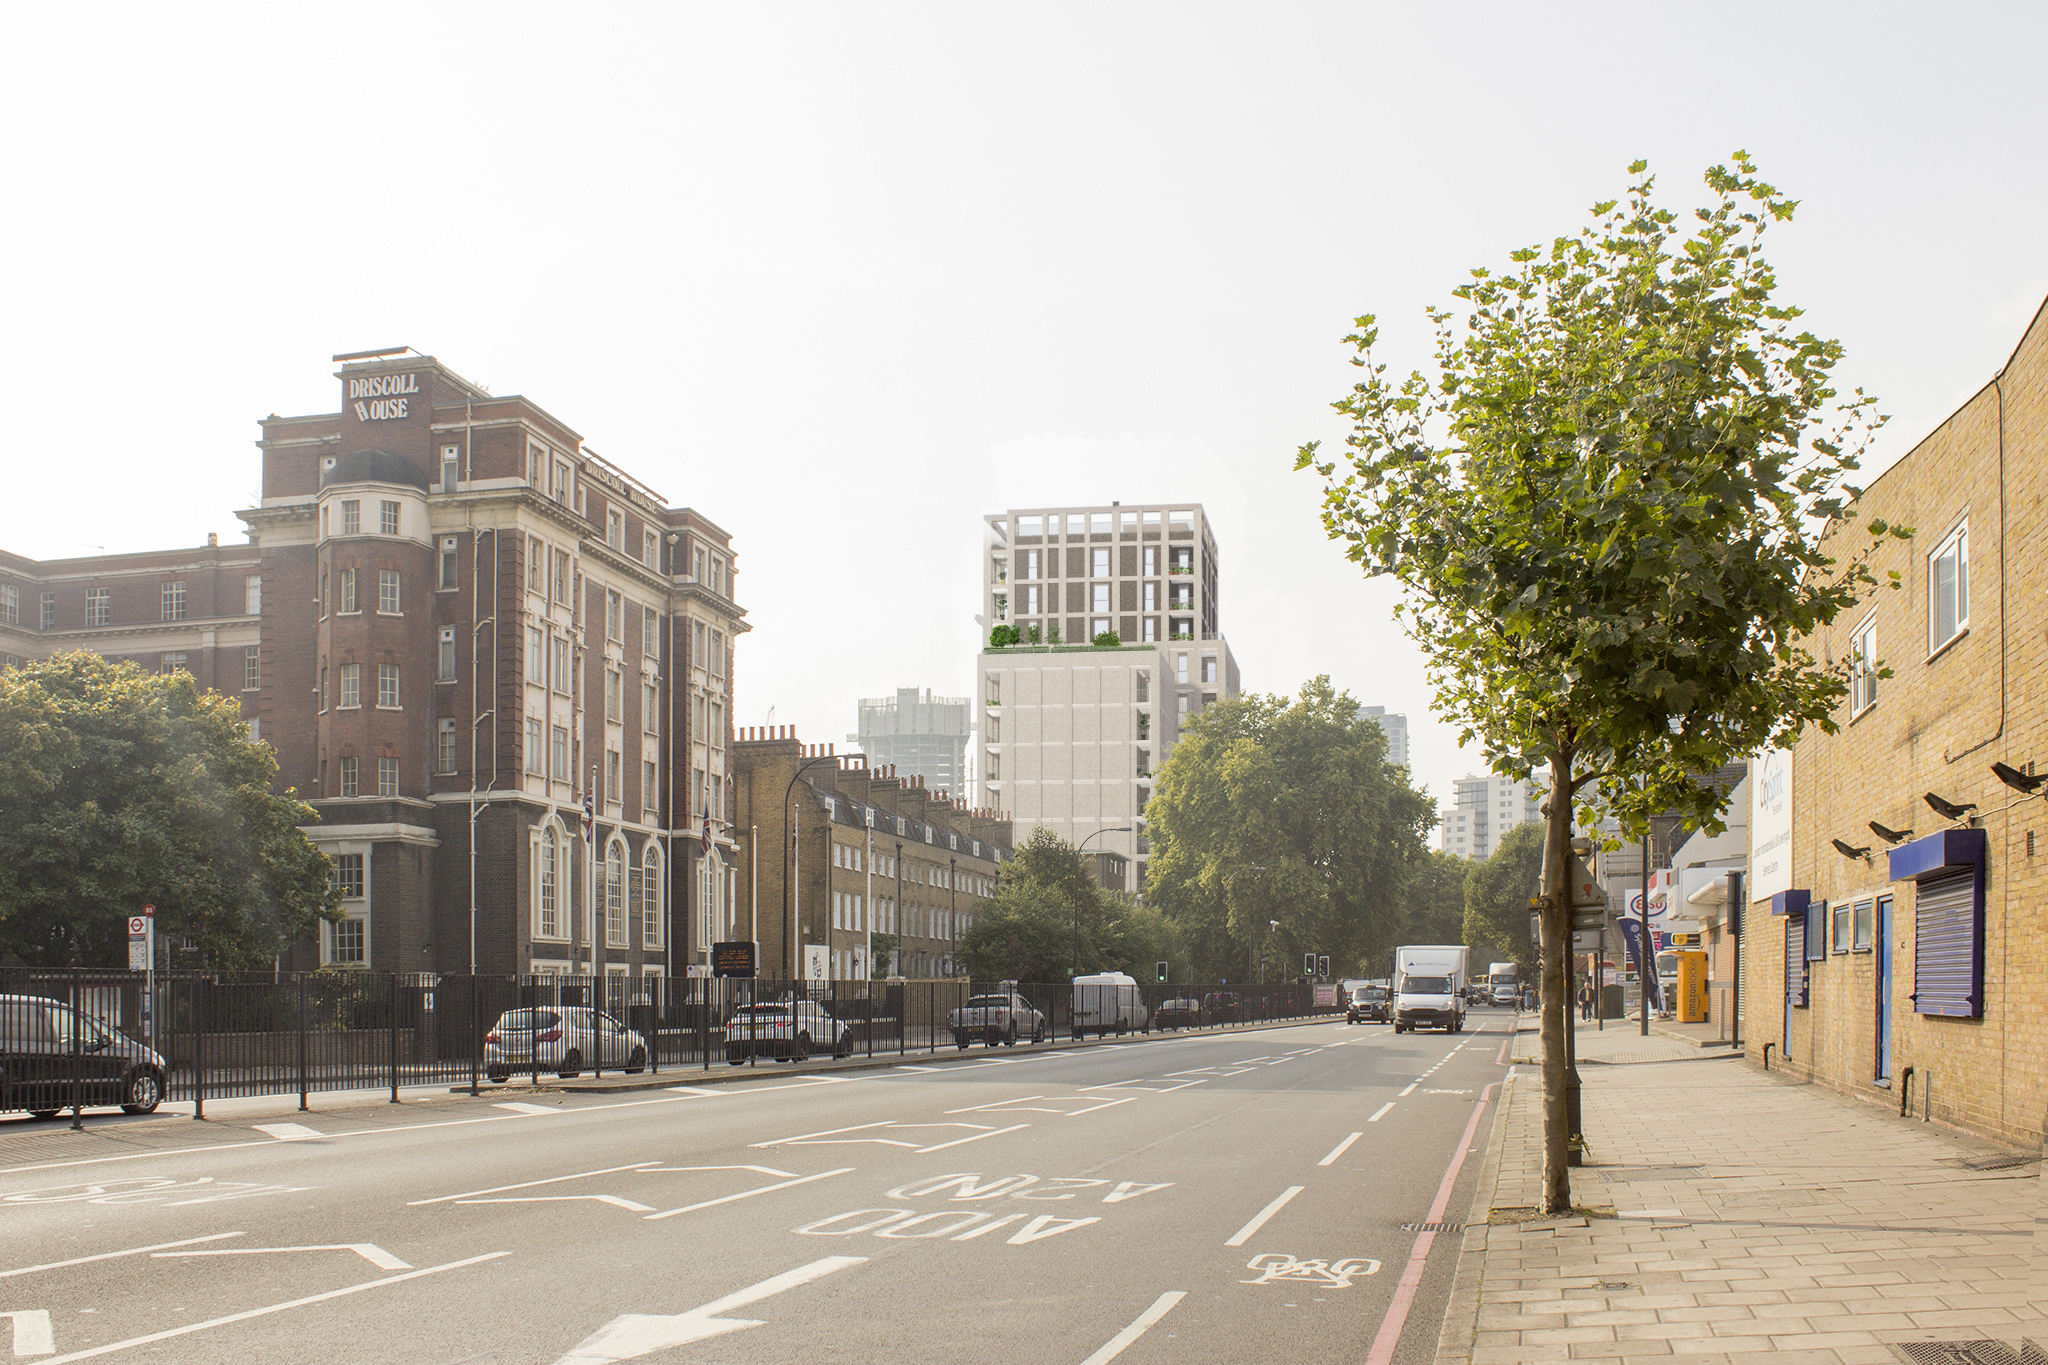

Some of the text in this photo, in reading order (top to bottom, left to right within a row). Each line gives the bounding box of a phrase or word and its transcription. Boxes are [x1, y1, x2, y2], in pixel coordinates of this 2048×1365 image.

[349, 373, 419, 399] DRISCOLL
[353, 398, 408, 422] HOUSE
[586, 459, 658, 515] DRISCOLL HOUSE
[790, 1208, 1102, 1245] A100
